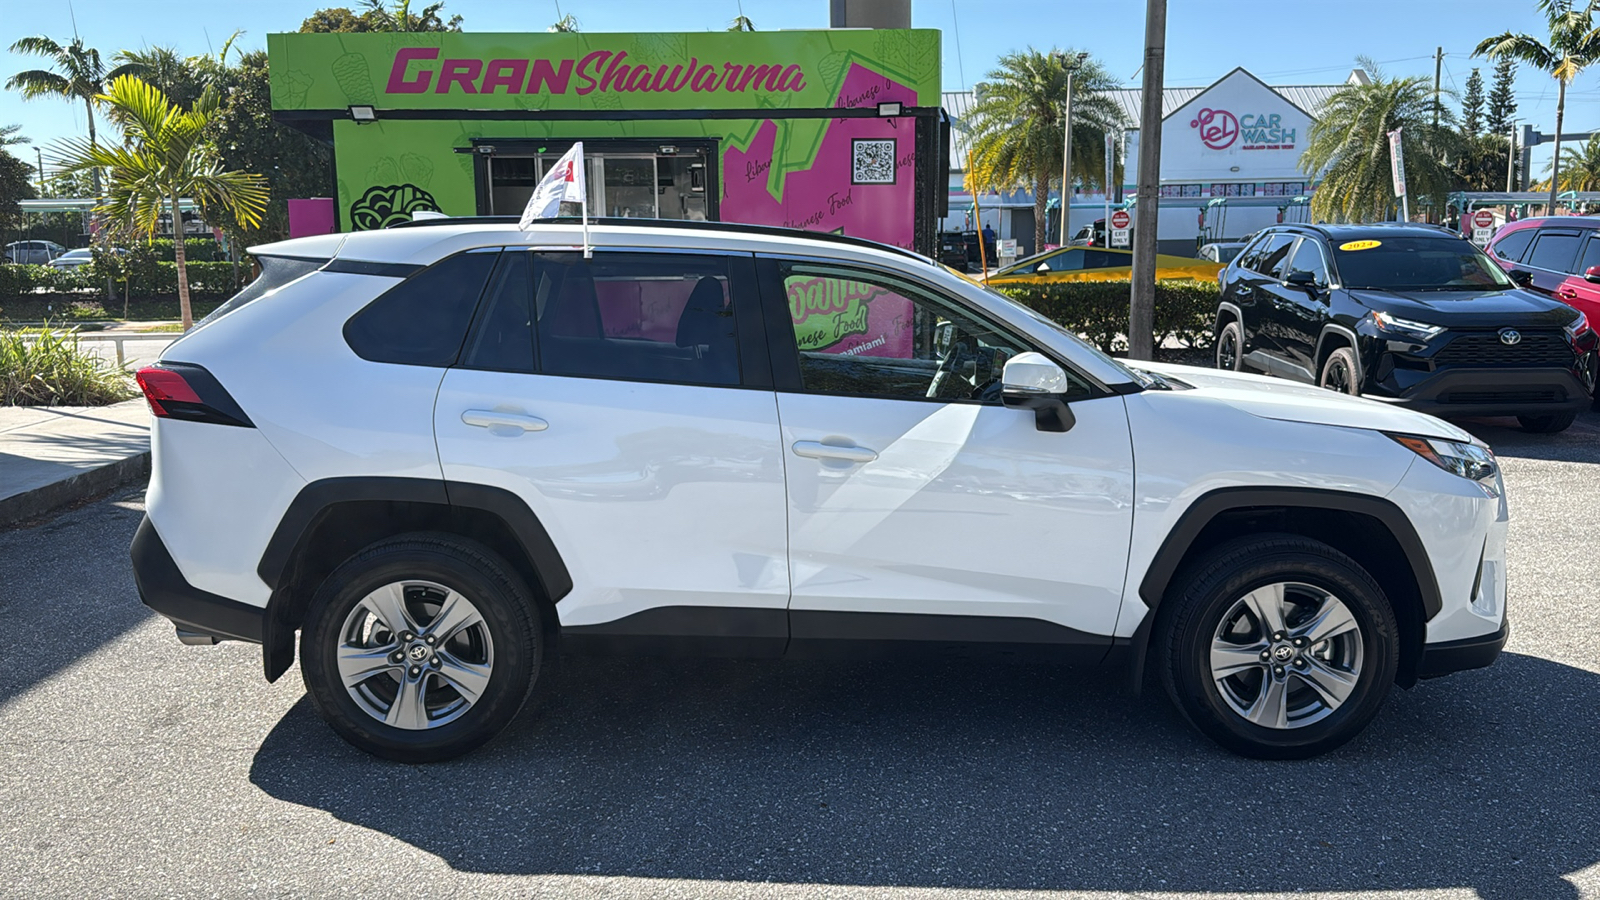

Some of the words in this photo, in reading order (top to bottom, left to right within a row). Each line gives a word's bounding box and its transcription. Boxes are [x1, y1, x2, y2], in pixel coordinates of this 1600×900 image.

[385, 47, 575, 94] GRAN
[575, 50, 807, 96] Shawarma
[1240, 114, 1281, 129] CAR
[1240, 128, 1296, 143] WASH
[827, 188, 854, 215] Food
[1348, 241, 1373, 249] 2024
[832, 307, 865, 338] Food
